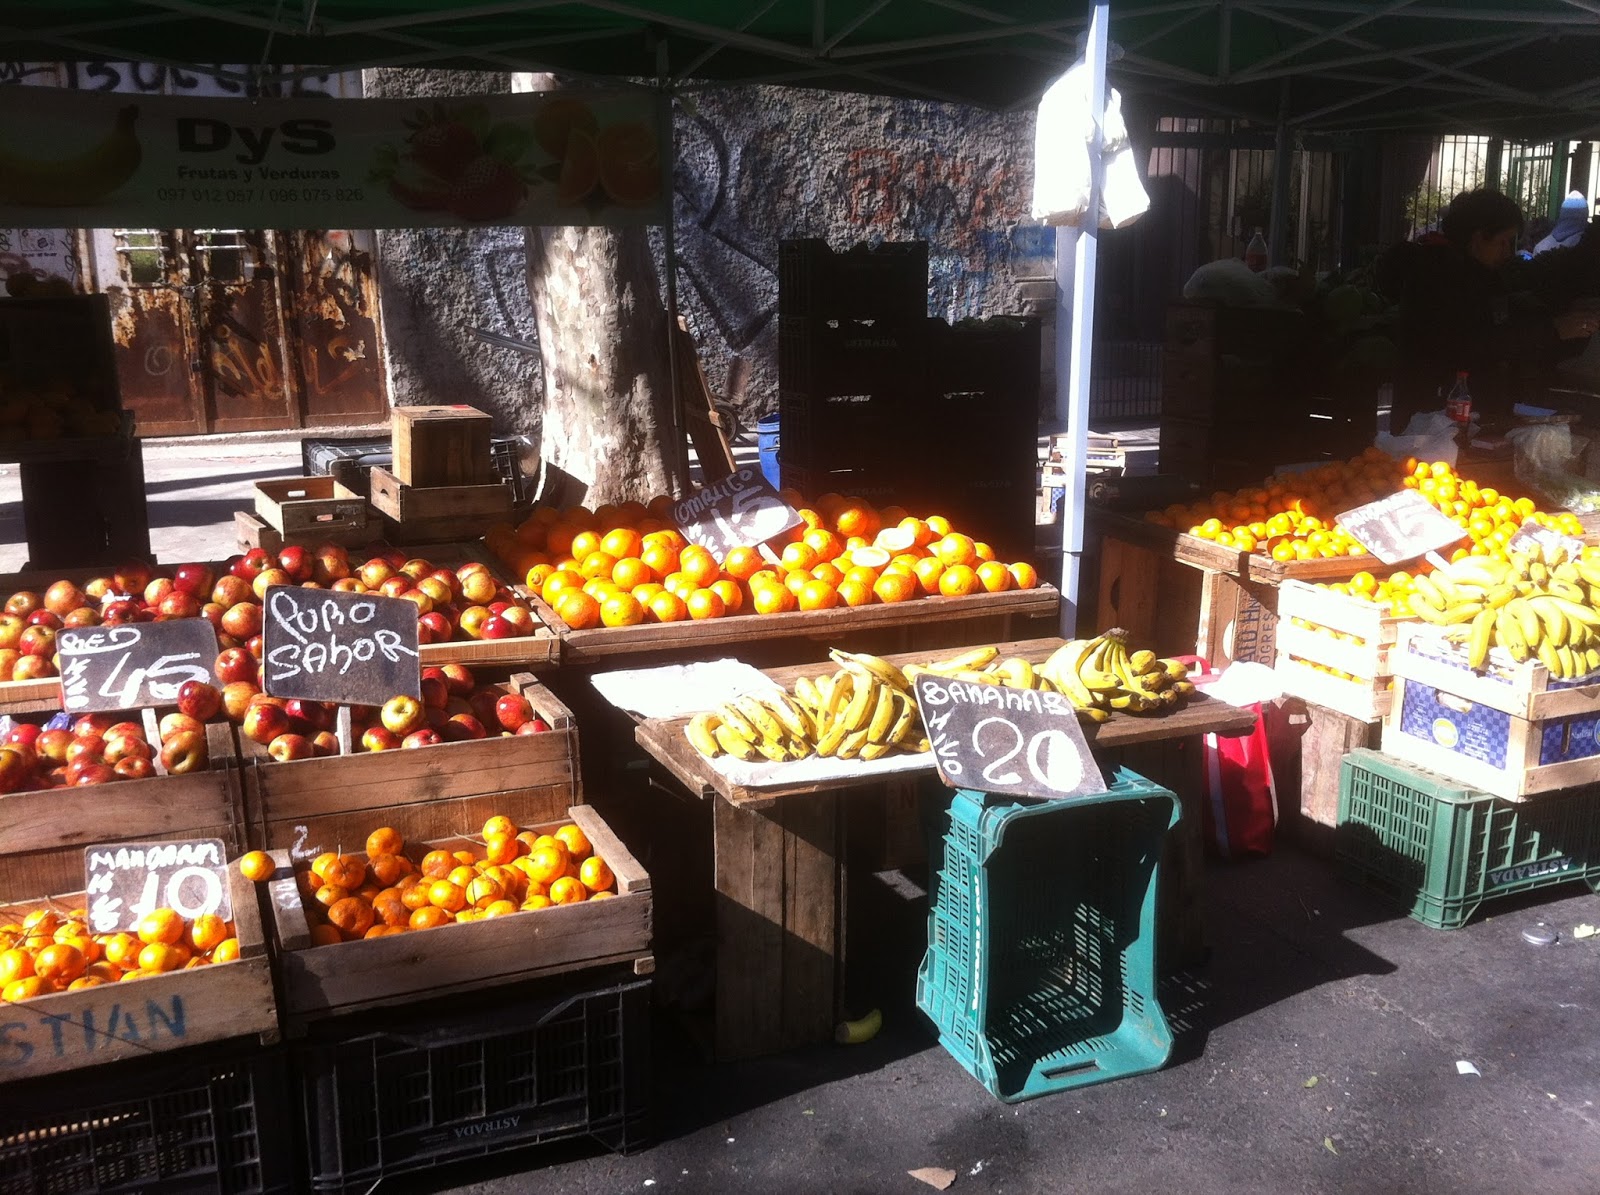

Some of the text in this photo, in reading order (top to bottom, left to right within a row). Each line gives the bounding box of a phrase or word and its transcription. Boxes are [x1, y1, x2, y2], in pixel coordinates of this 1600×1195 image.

[176, 118, 336, 165] DyS
[157, 188, 186, 202] 097
[192, 188, 221, 203] 012
[177, 165, 341, 184] Frutas y Verduras
[709, 485, 790, 547] 15
[270, 590, 377, 643] PURO
[60, 627, 142, 656] RED
[98, 651, 211, 708] 45
[922, 681, 1071, 716] BANANAS
[928, 710, 963, 776] KILO
[971, 716, 1086, 793] 20
[1490, 857, 1572, 885] ASTRADA
[128, 866, 223, 931] 10
[454, 1115, 521, 1139] ASTRADA
